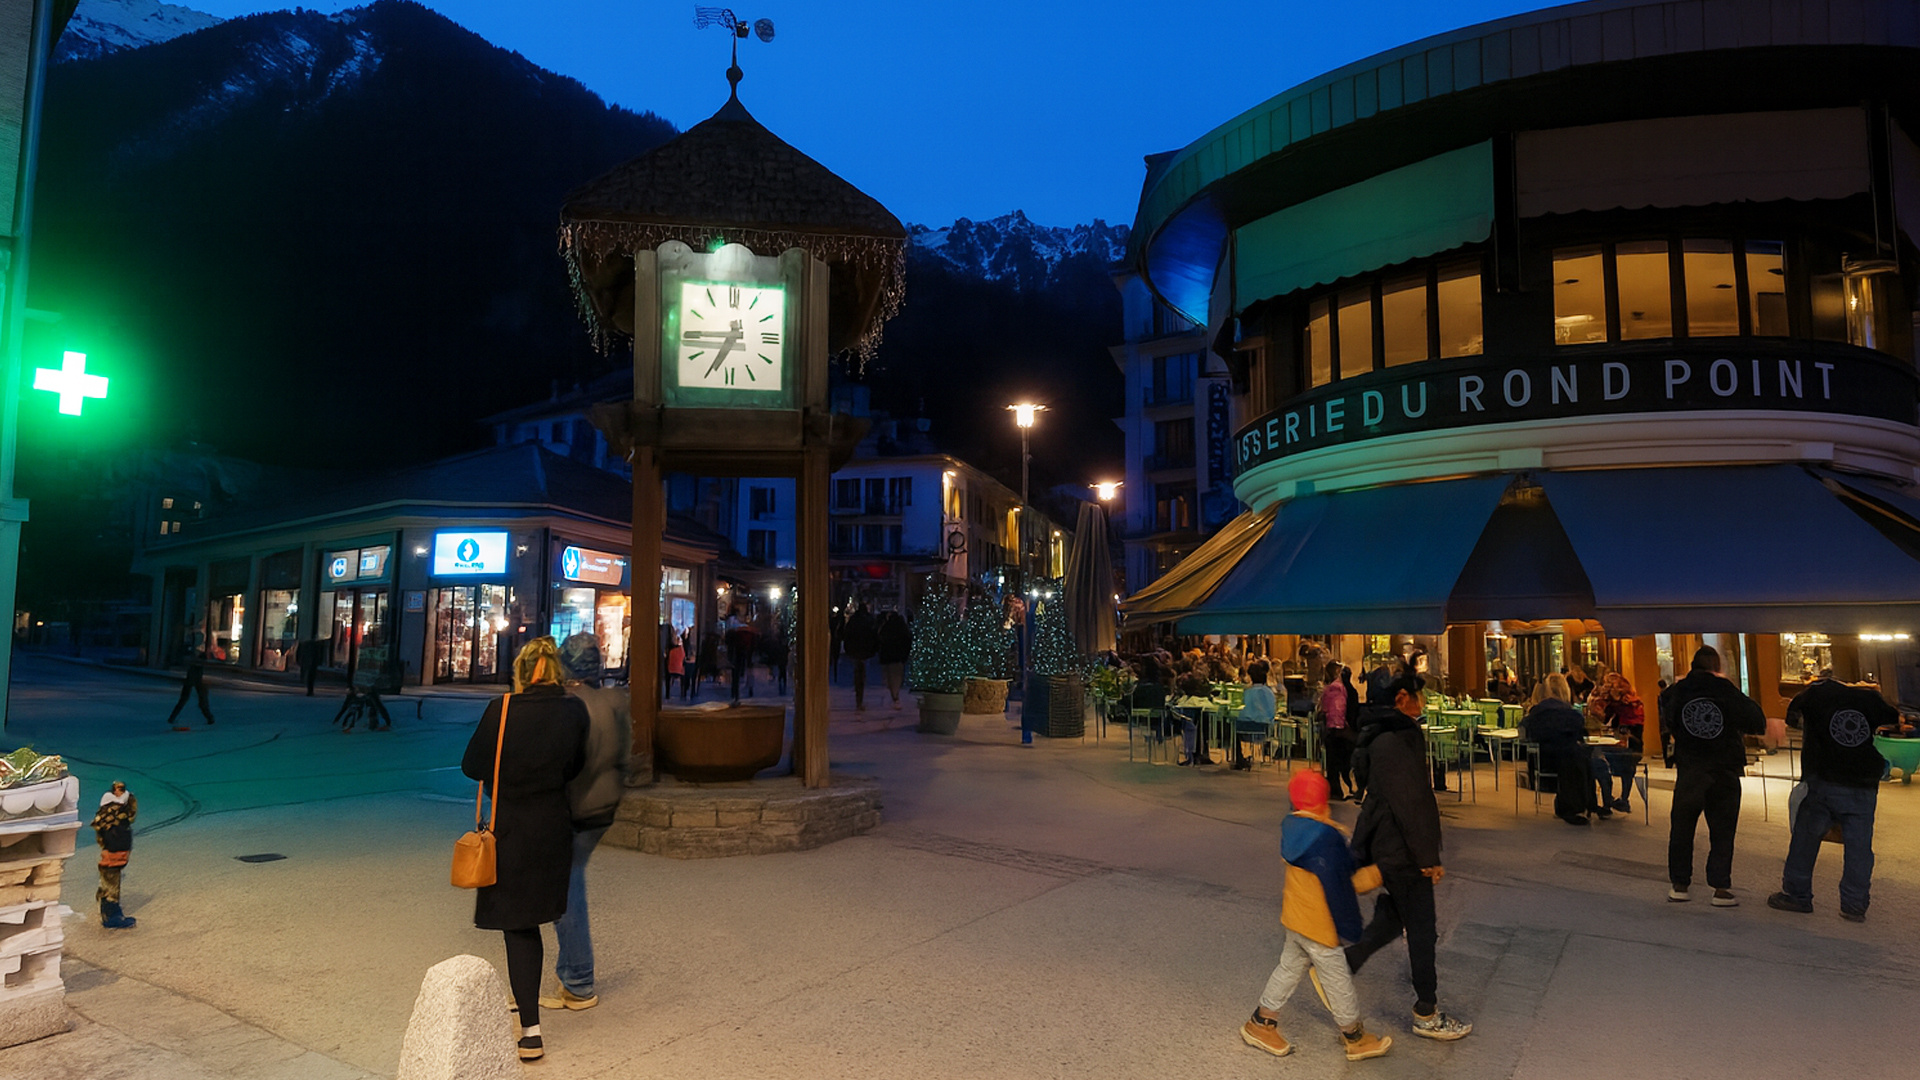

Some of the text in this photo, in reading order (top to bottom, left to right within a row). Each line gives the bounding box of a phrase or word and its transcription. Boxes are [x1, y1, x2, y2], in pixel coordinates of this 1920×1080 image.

[1362, 377, 1427, 427] DU
[1458, 362, 1632, 412] ROND
[1664, 358, 1835, 400] POINT
